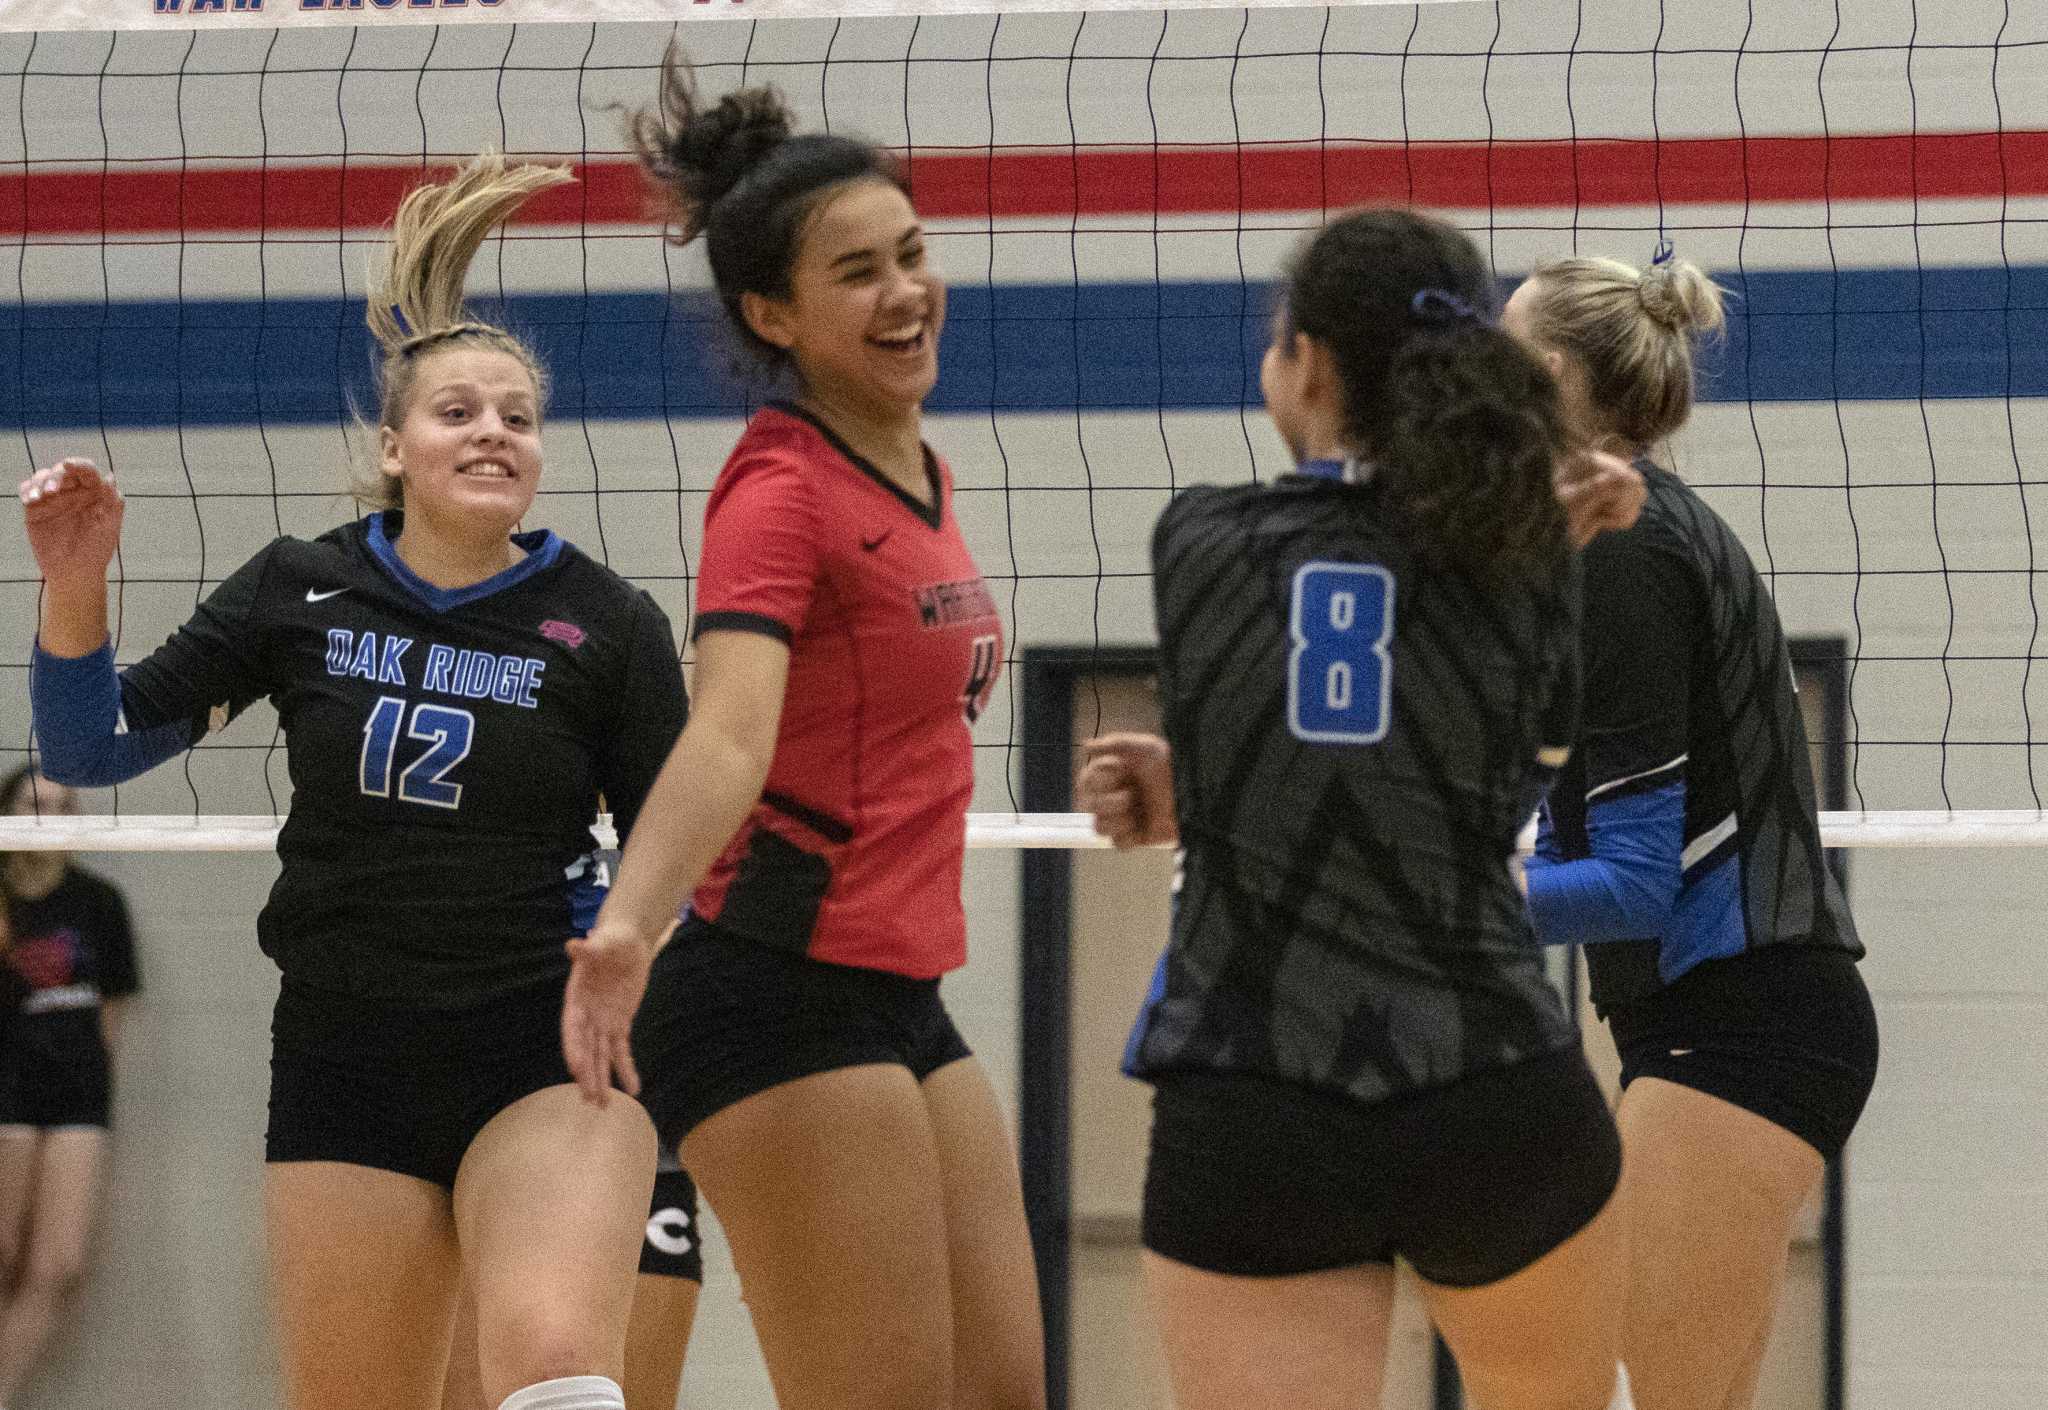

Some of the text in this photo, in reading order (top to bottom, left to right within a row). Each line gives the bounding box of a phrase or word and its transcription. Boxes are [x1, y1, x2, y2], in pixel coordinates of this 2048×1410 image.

[326, 629, 546, 708] OAK RIDGE
[1288, 561, 1395, 745] 8
[360, 696, 475, 809] 12
